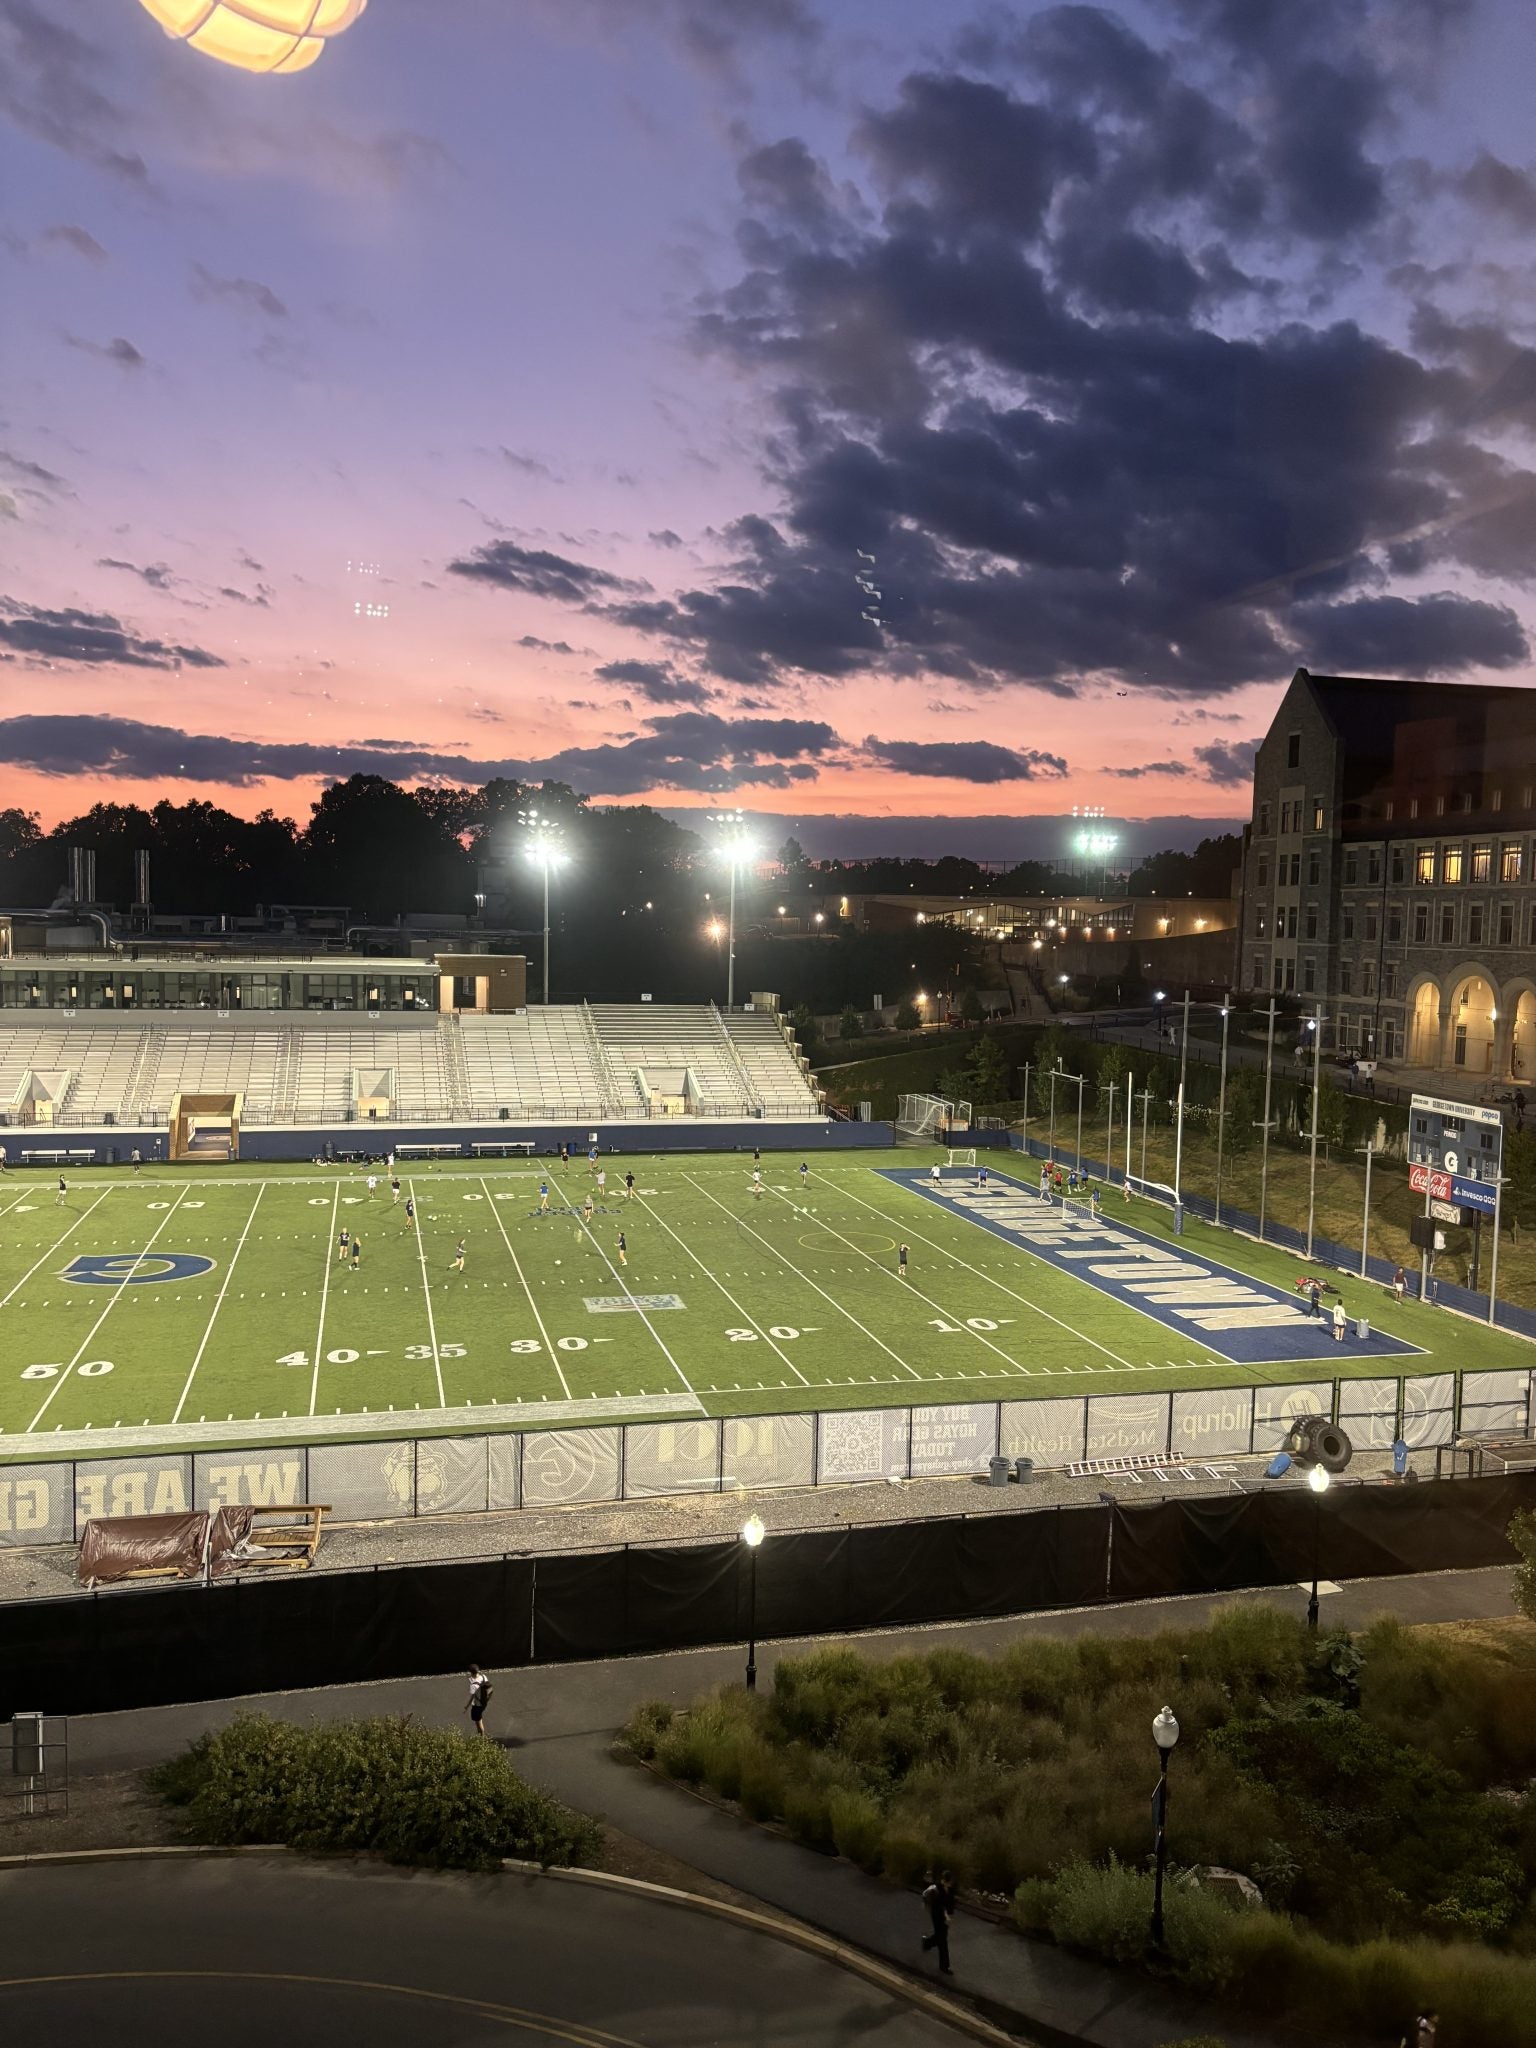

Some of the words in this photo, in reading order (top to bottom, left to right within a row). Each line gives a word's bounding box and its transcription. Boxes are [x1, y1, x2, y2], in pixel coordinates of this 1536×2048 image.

[1432, 1100, 1455, 1112] GEORGETOWN
[1455, 1105, 1476, 1117] UNIVERSITY
[1444, 1151, 1458, 1173] G
[1411, 1168, 1449, 1198] CocaCola
[1461, 1188, 1483, 1202] Invesco
[725, 1326, 800, 1342] 20
[927, 1317, 999, 1333] 10
[403, 1342, 468, 1360] 35
[510, 1336, 589, 1354] 30
[275, 1348, 360, 1367] 40
[20, 1360, 115, 1380] 50
